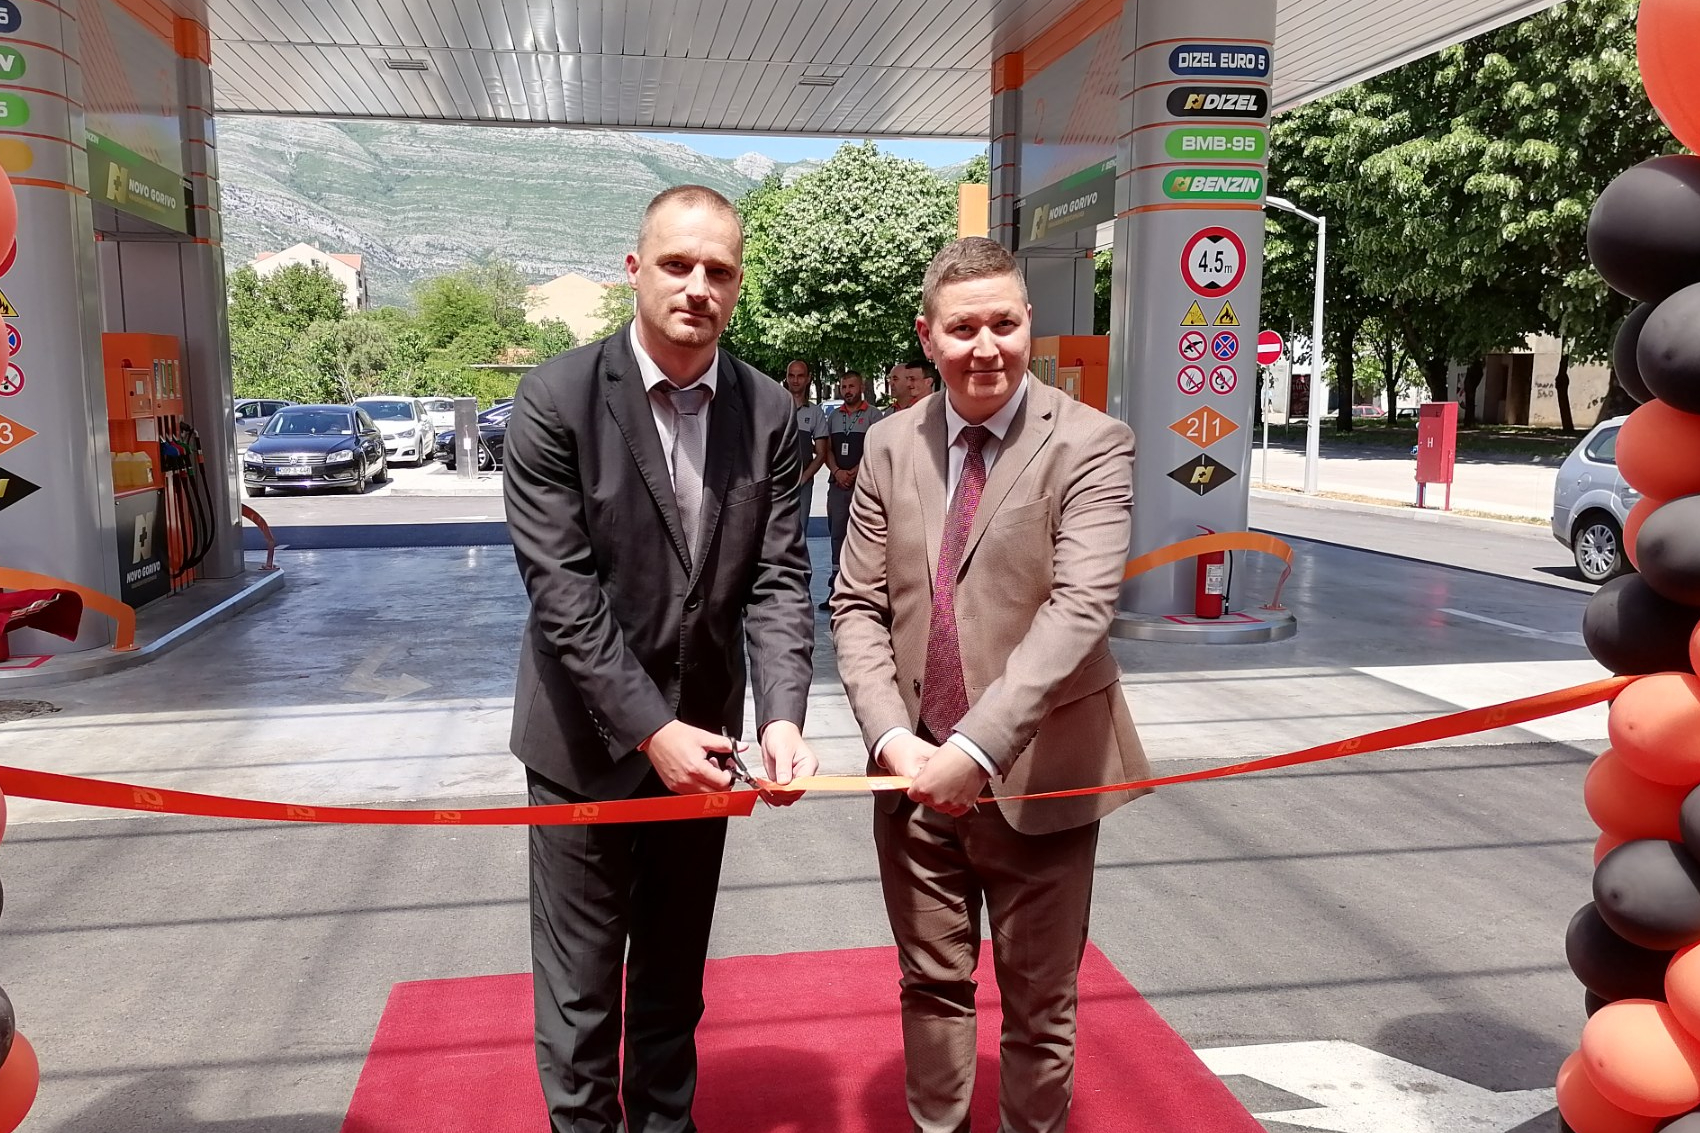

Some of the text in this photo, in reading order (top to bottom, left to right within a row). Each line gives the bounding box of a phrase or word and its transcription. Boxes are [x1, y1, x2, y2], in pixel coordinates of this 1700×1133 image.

[1178, 52, 1265, 70] DIZEL EURO 5
[1203, 94, 1258, 111] DIZEL
[1182, 136, 1256, 152] BMB-95
[128, 178, 150, 198] NOVO
[150, 188, 176, 209] GORIVO
[1190, 177, 1259, 193] BENZIN
[1048, 203, 1068, 221] NOVO
[1069, 191, 1098, 213] GORIVO
[1427, 436, 1434, 448] H
[126, 568, 141, 584] NOVO
[141, 560, 161, 577] GORIVO
